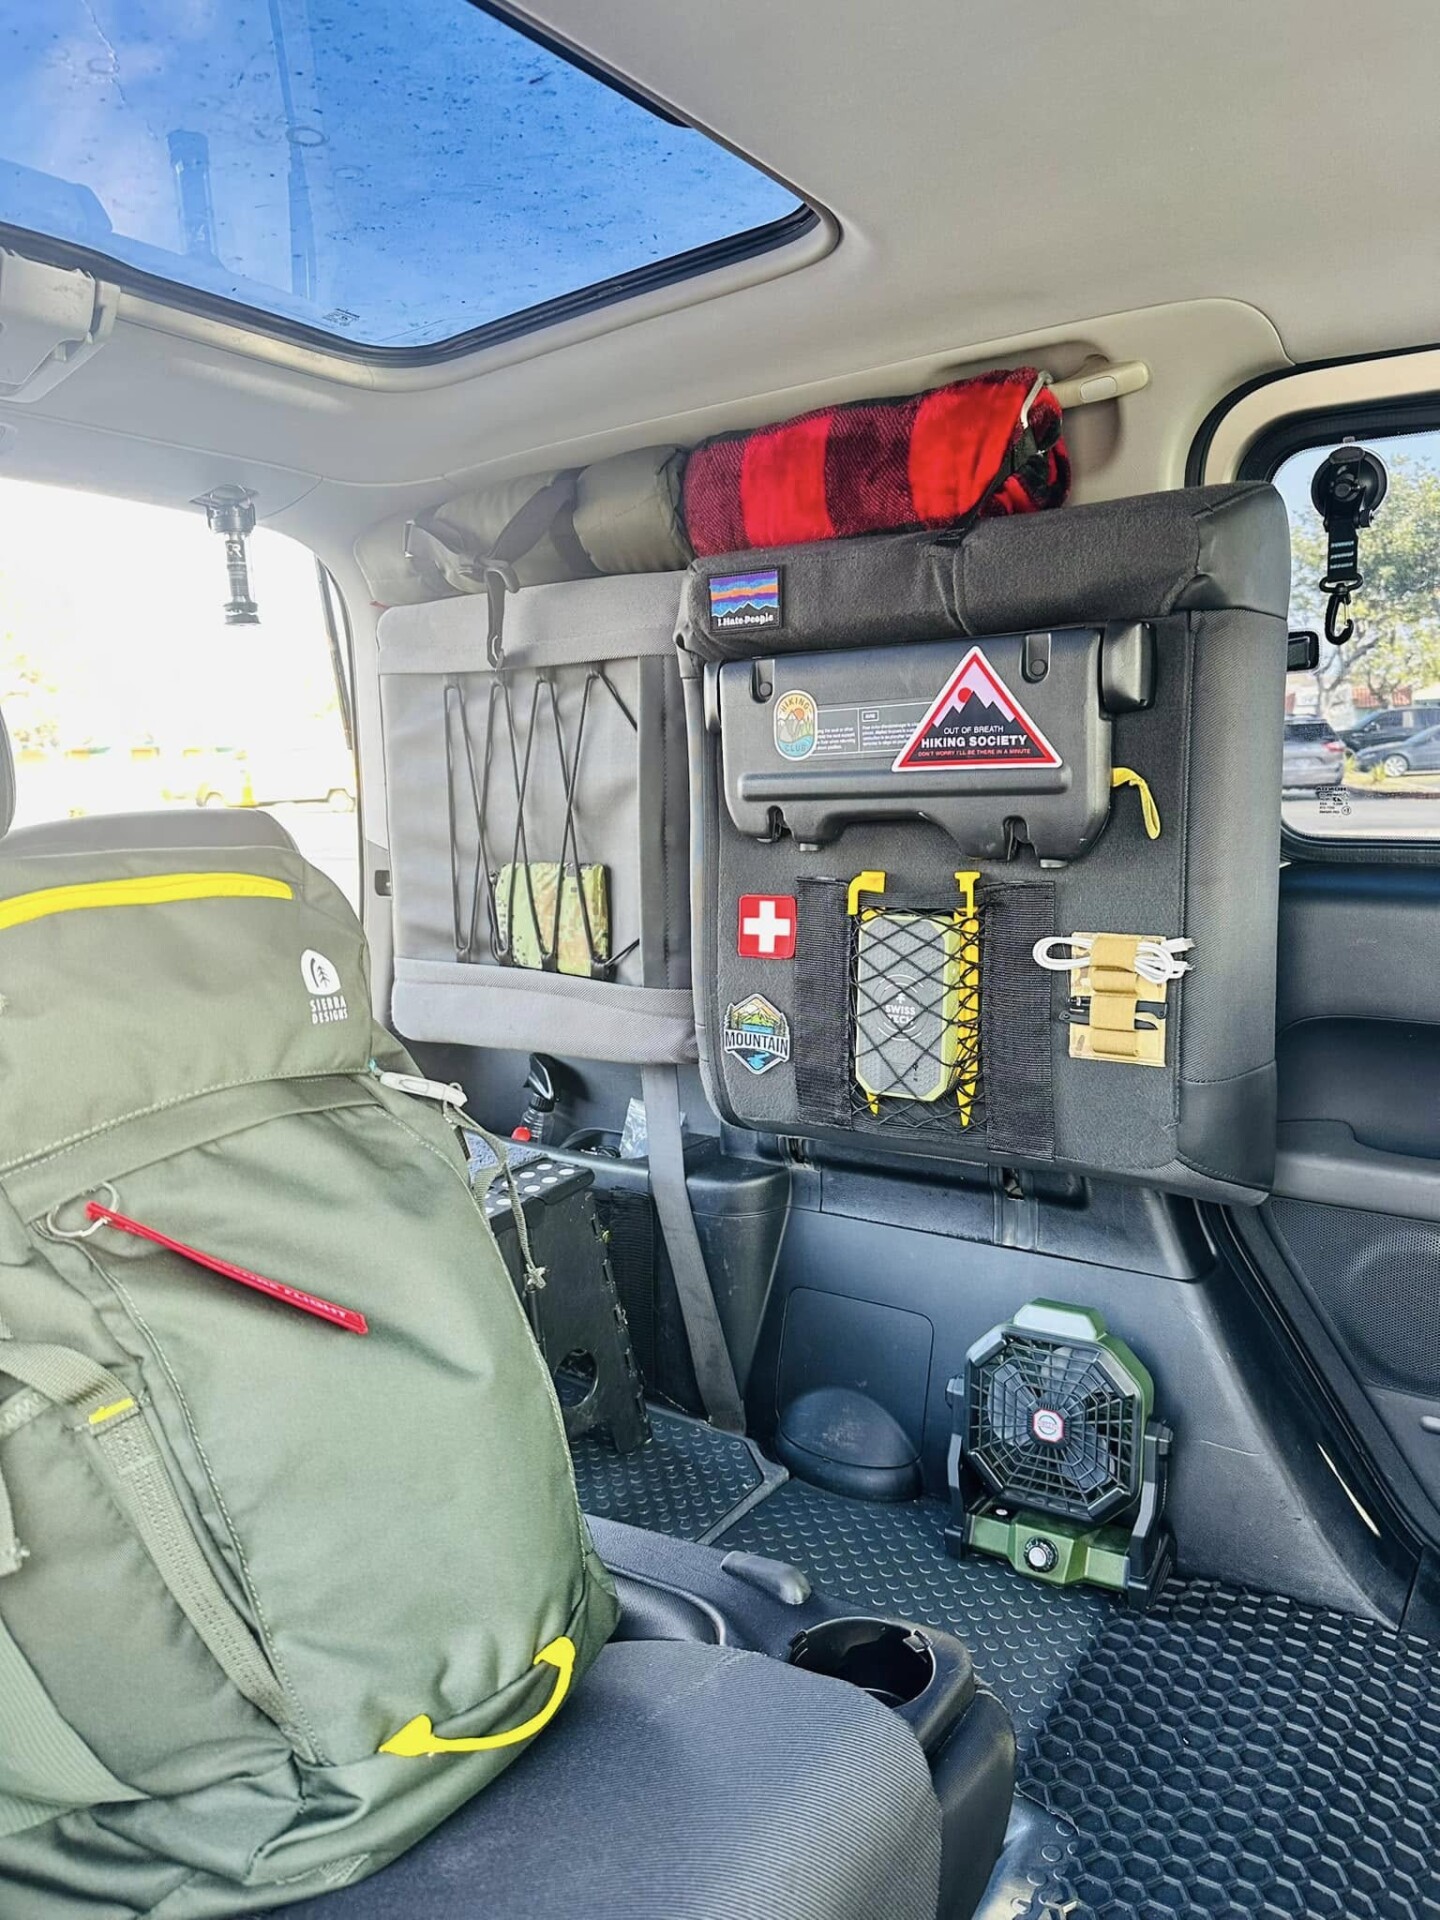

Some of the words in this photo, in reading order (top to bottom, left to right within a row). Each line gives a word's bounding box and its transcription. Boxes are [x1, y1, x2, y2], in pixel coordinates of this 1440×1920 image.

[717, 617, 722, 627] I
[723, 616, 744, 626] Hate
[744, 612, 774, 625] People
[781, 697, 810, 713] HIKING
[943, 726, 959, 735] OUT
[961, 726, 972, 734] OF
[973, 725, 1004, 734] BREATH
[784, 743, 807, 752] CLUB
[921, 737, 966, 749] HIKING
[969, 734, 1027, 747] SOCIETY
[310, 995, 347, 1012] SIERRA
[885, 1004, 916, 1015] SWISS
[312, 1008, 348, 1025] DESIGNS
[725, 1030, 788, 1057] MOUNTAIN
